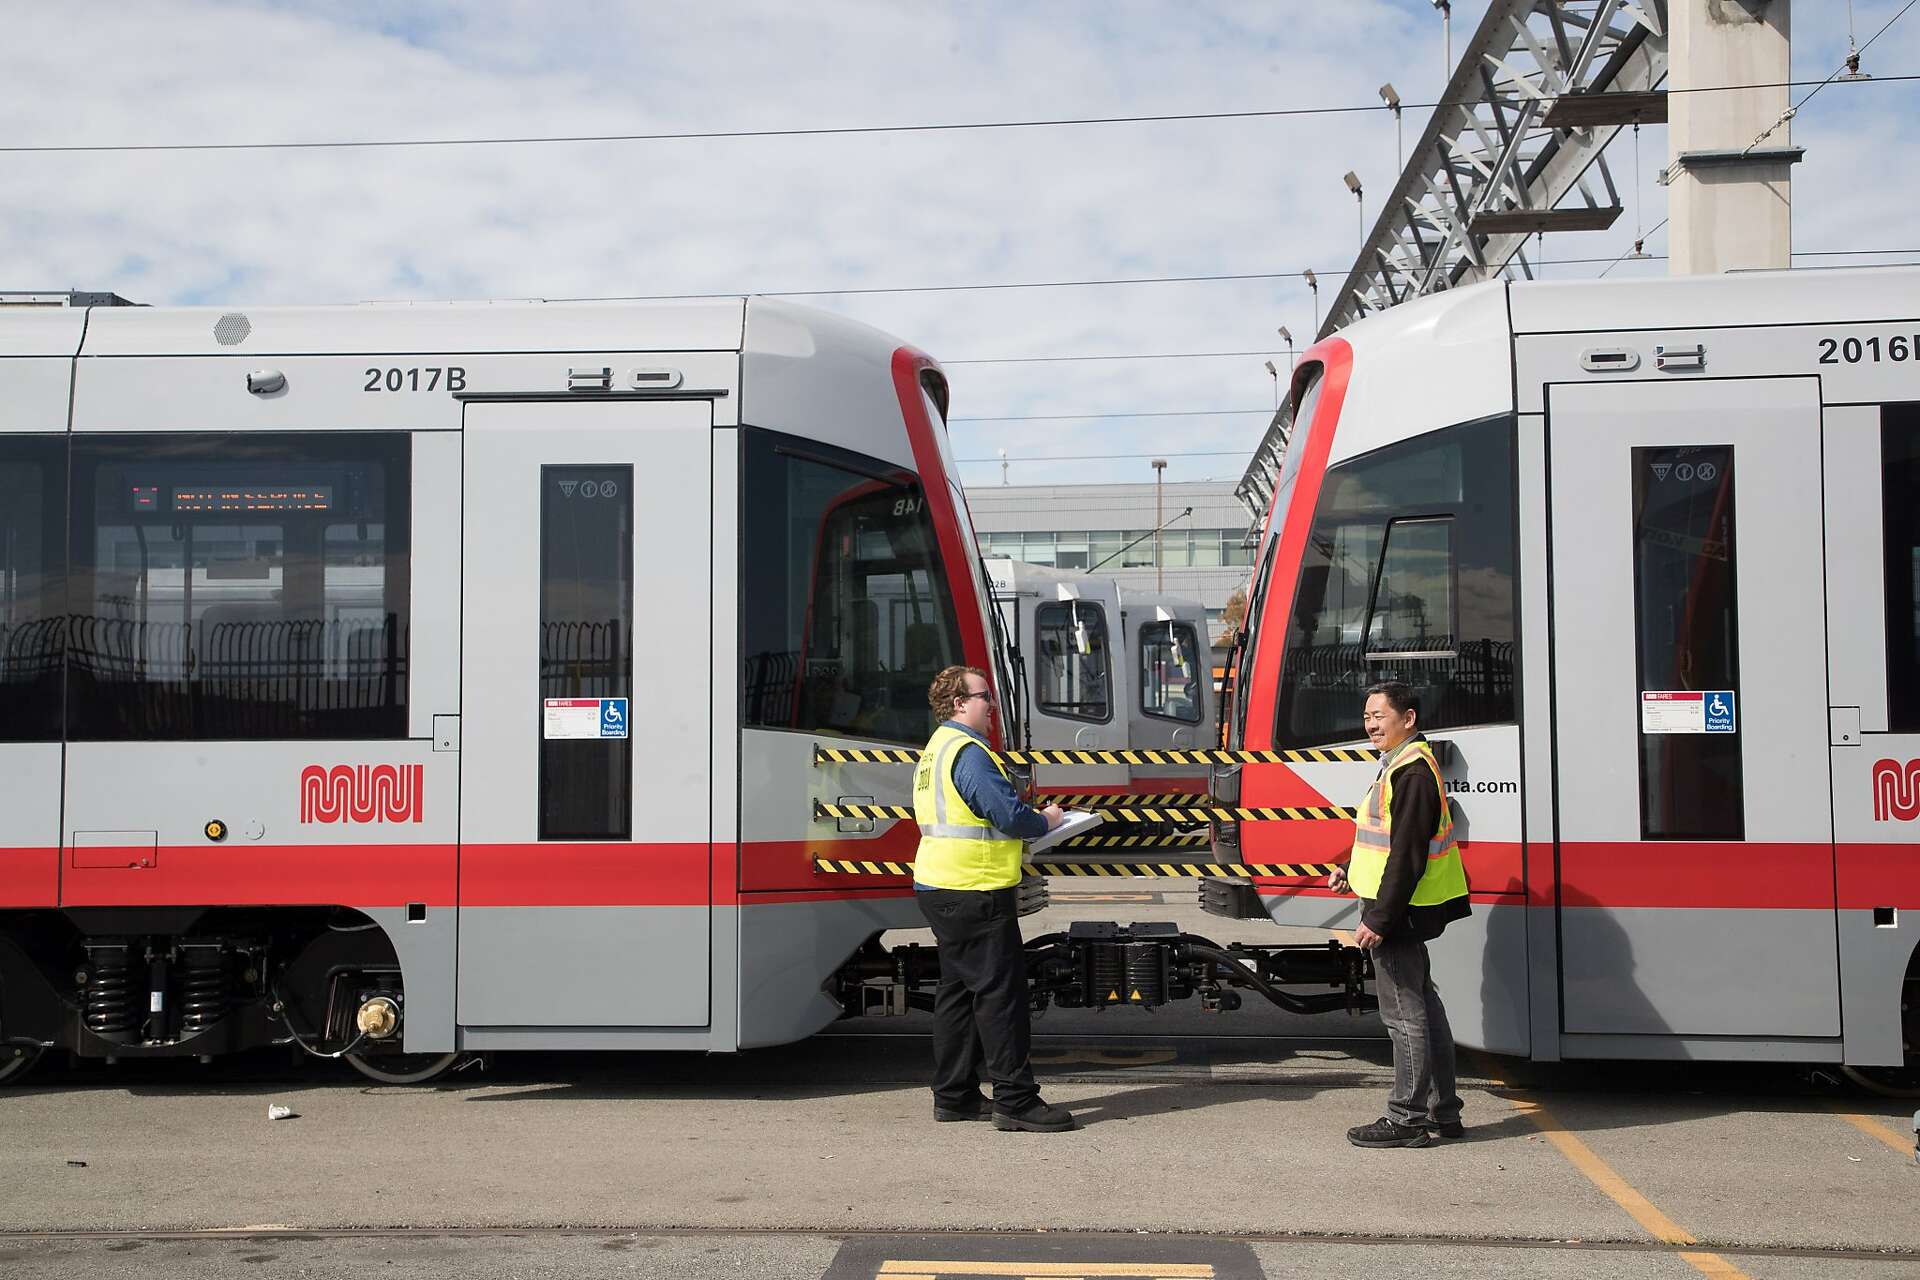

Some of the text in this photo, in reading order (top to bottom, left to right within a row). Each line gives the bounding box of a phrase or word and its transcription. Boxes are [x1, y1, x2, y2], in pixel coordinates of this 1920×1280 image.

[364, 367, 466, 392] 2017B
[603, 723, 624, 731] Priority
[1708, 717, 1731, 725] Priority
[300, 764, 423, 823] MUNI
